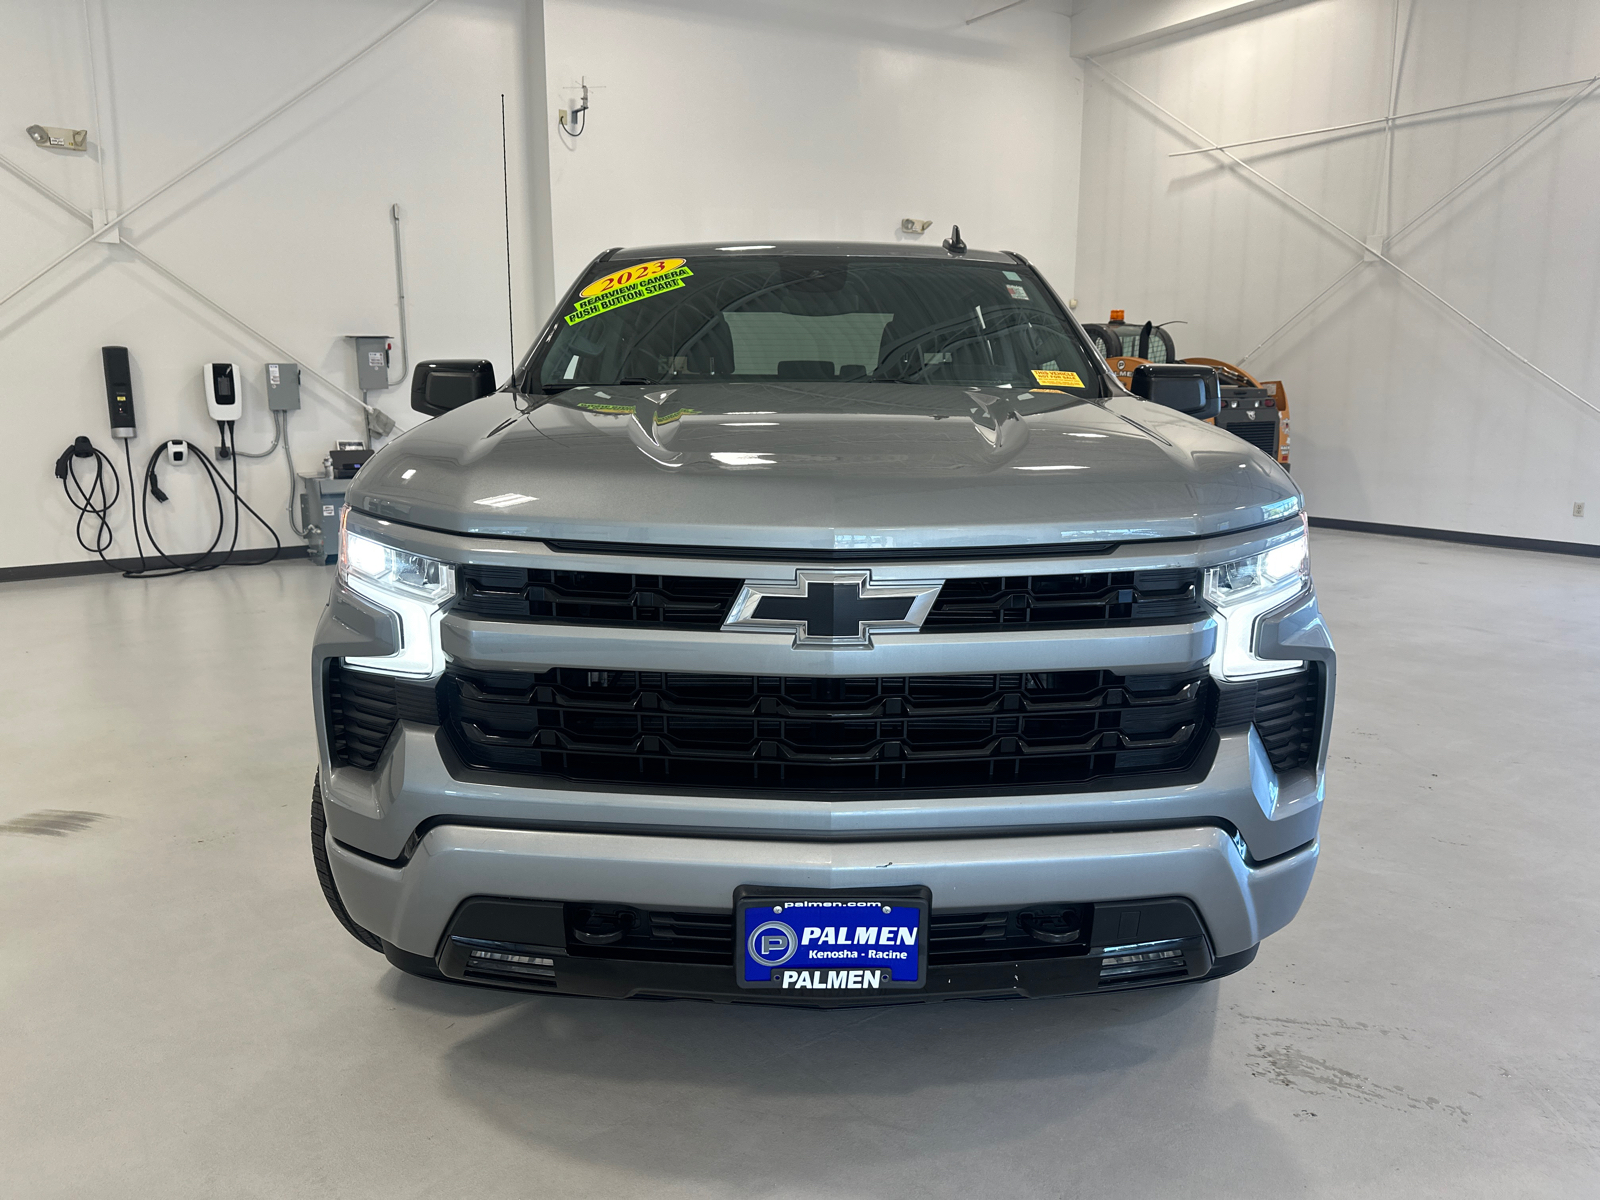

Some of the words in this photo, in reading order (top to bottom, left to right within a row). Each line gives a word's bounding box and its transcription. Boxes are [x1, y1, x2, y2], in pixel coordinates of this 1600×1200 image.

[600, 261, 665, 292] 2023
[580, 283, 636, 308] REARVIEW
[640, 269, 686, 287] CAMERA
[569, 306, 599, 322] PUSH
[601, 291, 644, 310] BUTTON
[646, 278, 680, 294] START
[761, 935, 788, 955] P
[801, 926, 918, 945] PALMEN
[808, 949, 858, 959] Kenosha
[868, 949, 908, 959] Racine
[782, 970, 881, 989] PALMEN
